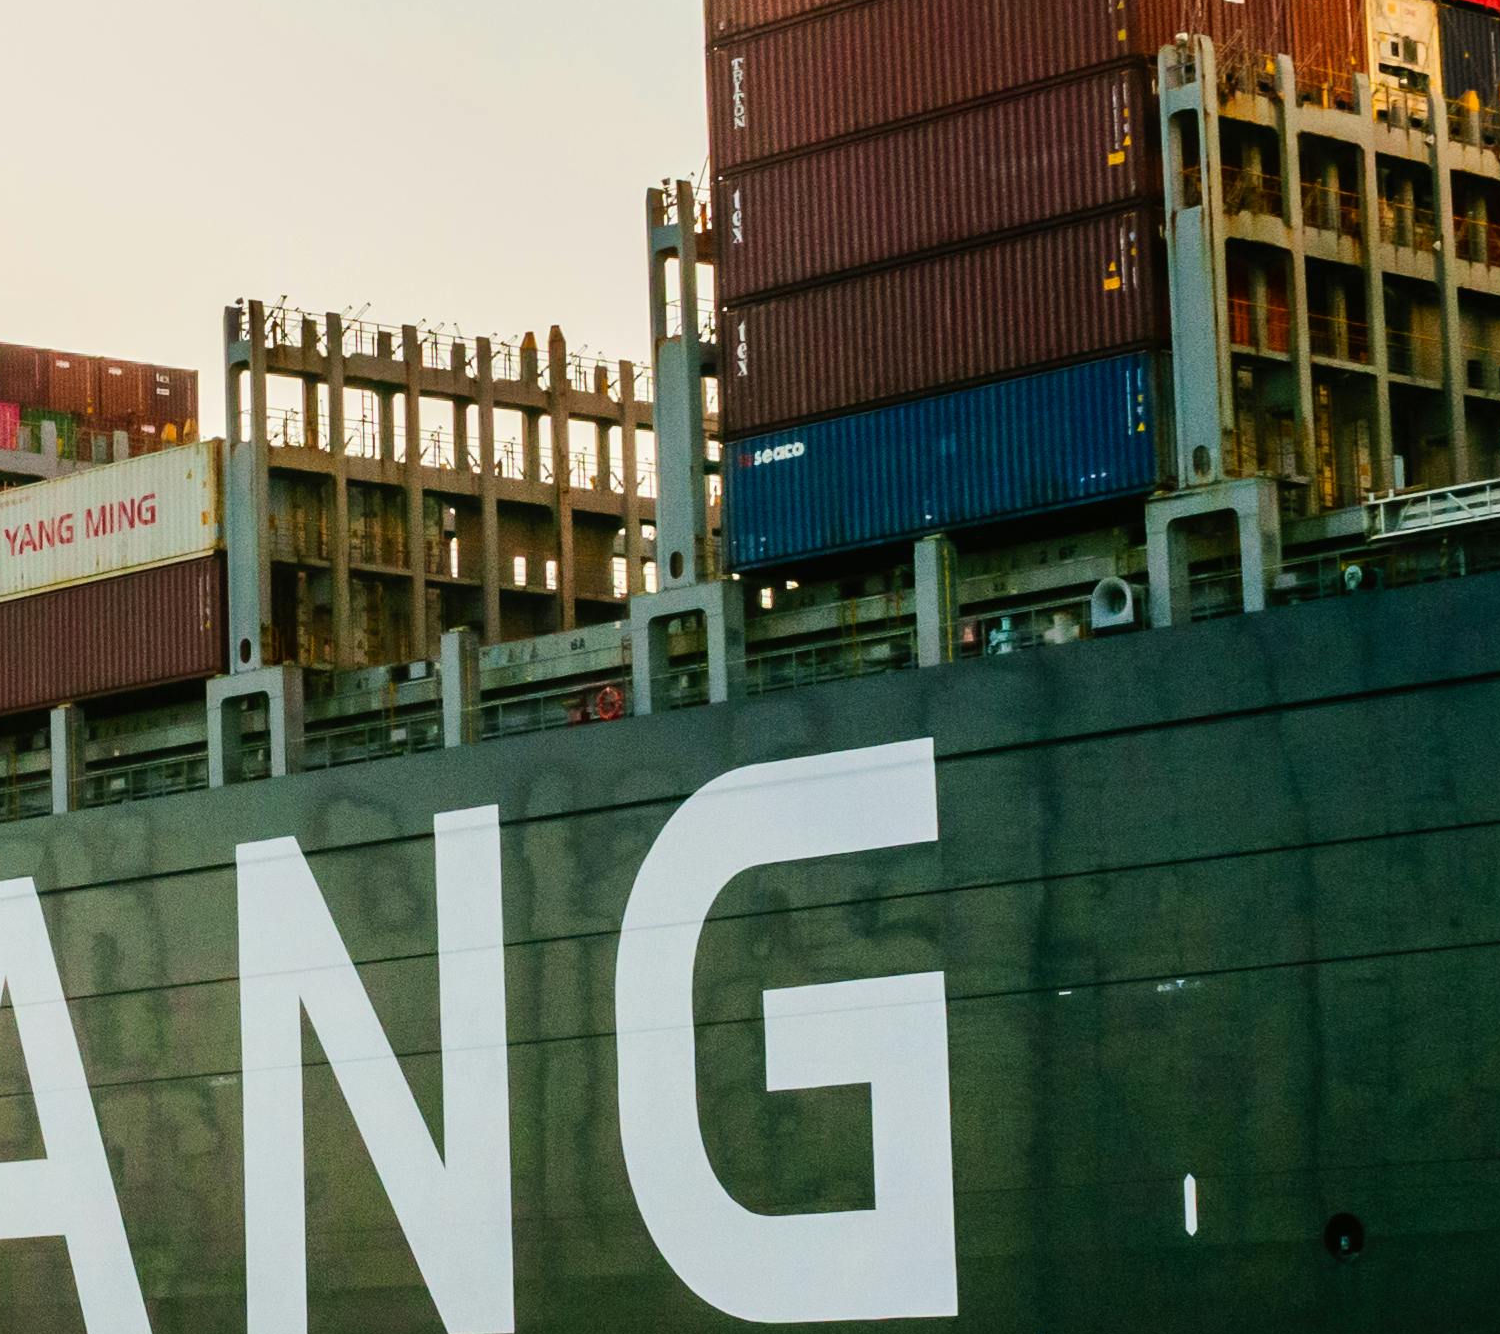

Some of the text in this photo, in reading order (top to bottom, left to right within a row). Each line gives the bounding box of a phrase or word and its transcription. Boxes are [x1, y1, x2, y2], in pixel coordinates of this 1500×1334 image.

[730, 57, 746, 130] TRITON
[732, 188, 743, 244] tex
[737, 320, 749, 376] tex
[754, 440, 805, 467] seaco
[3, 492, 157, 557] YANG MING
